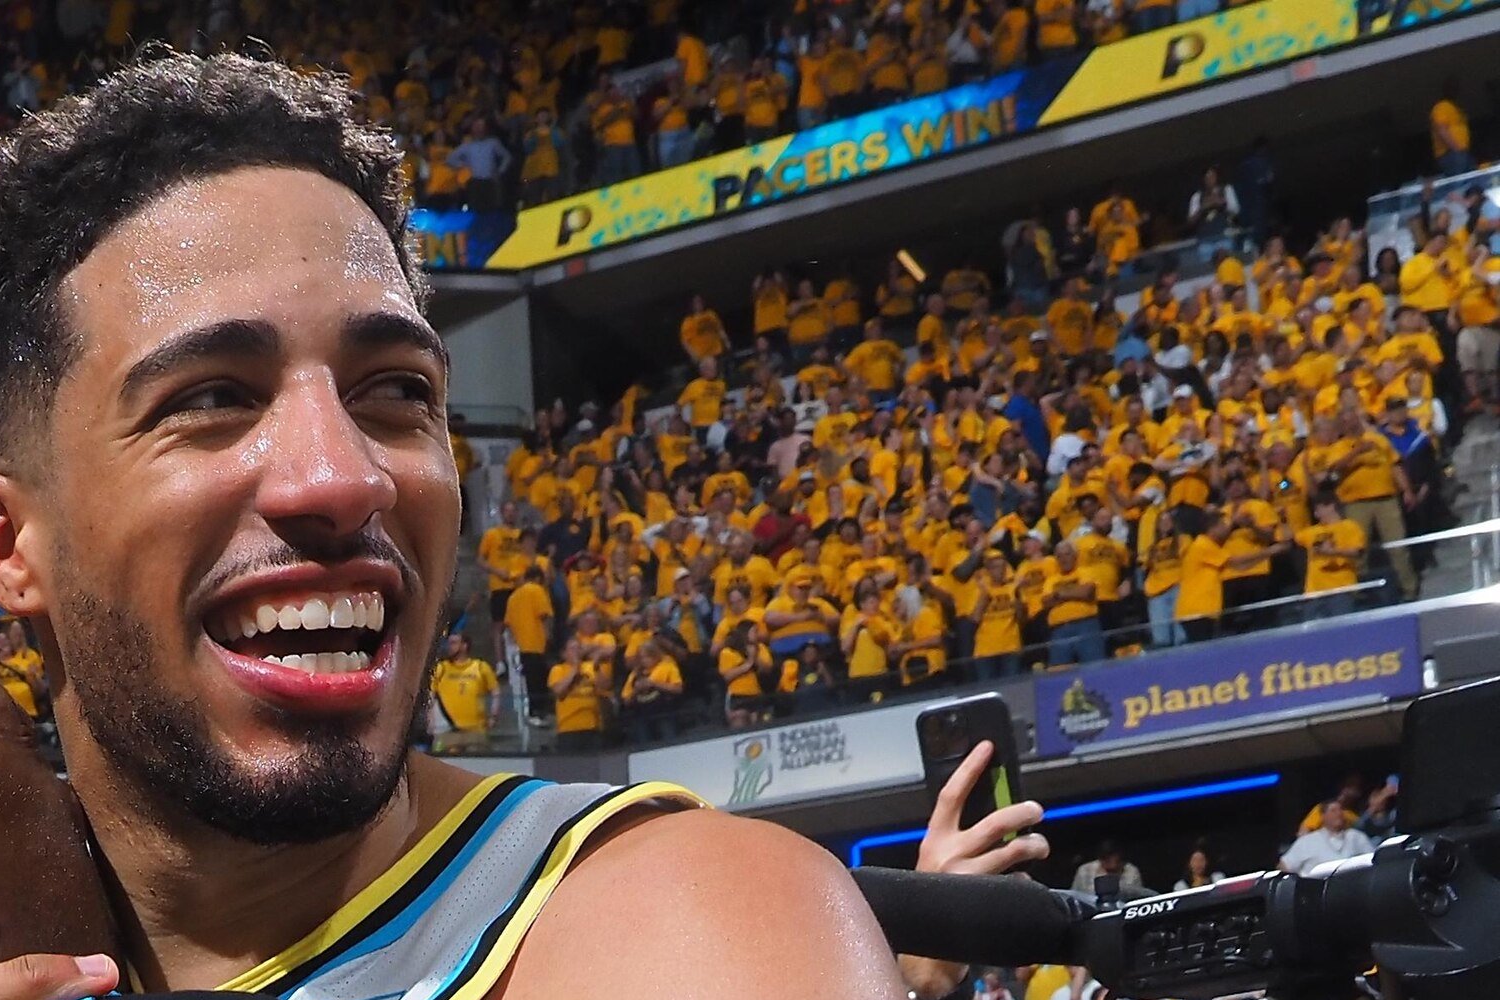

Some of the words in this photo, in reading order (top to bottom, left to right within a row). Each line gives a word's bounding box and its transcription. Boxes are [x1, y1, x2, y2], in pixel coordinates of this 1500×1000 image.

[713, 131, 889, 216] PACERS
[902, 95, 1017, 158] WIN!
[1123, 671, 1250, 728] planet
[1260, 650, 1401, 697] fitness
[1124, 898, 1179, 920] SONY
